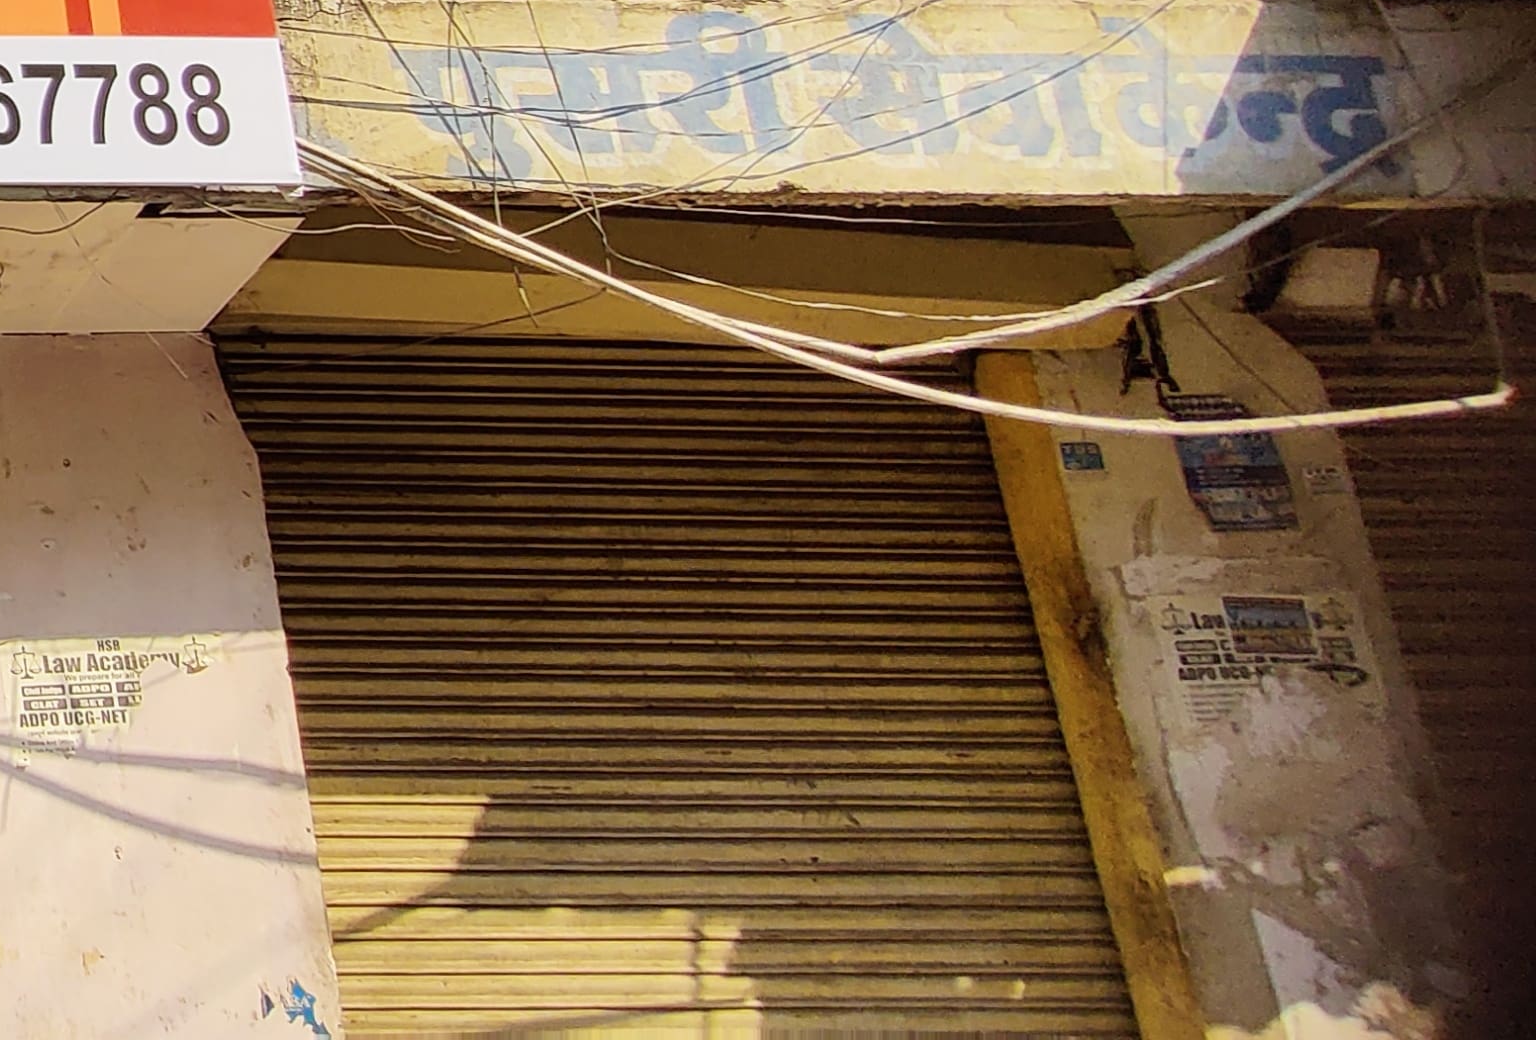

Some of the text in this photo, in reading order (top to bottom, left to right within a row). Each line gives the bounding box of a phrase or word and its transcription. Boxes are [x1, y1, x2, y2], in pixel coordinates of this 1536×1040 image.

[96, 639, 121, 652] HSB
[42, 654, 81, 674] Law
[20, 709, 128, 728] ADPO UCG-NET
